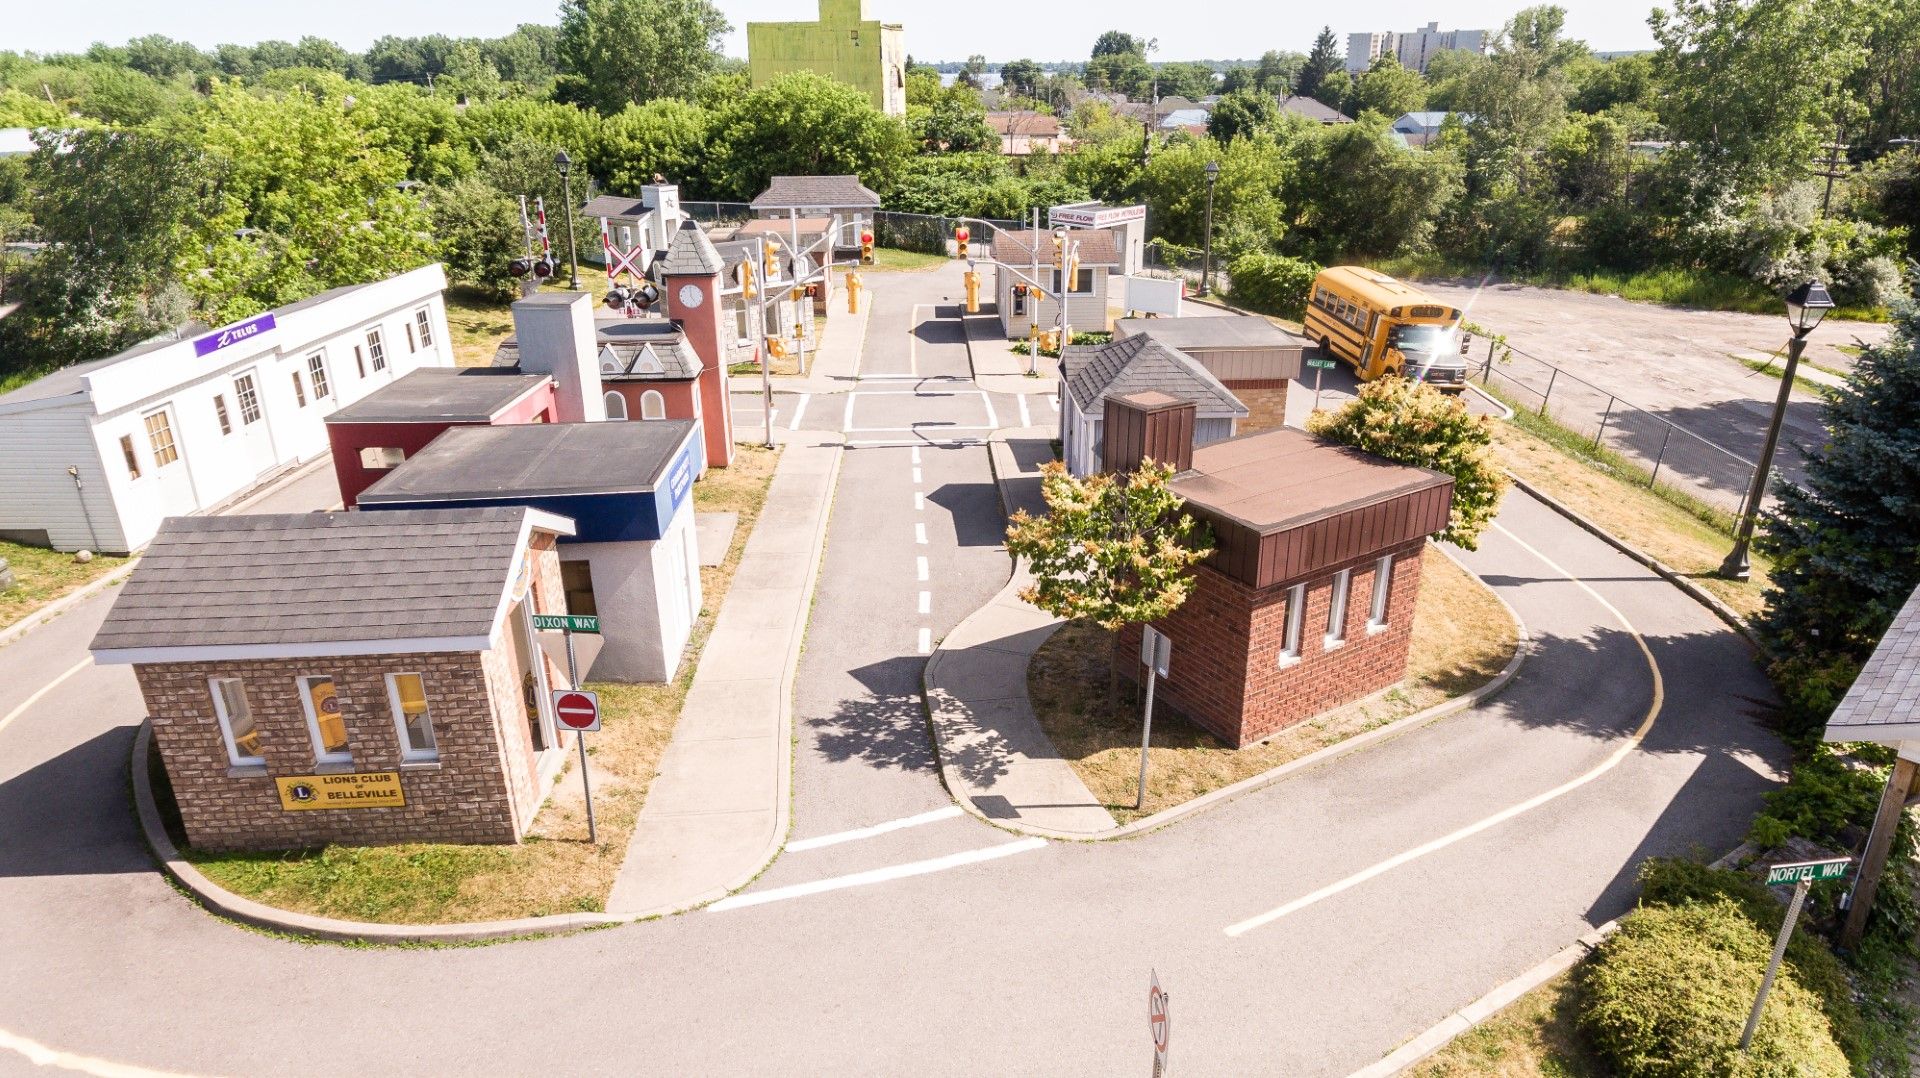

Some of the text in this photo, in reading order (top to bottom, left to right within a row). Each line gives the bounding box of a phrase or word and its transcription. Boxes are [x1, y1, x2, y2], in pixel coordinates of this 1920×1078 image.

[1058, 212, 1094, 222] FREE FLOW
[231, 324, 258, 340] TELUS
[534, 617, 596, 629] DIXON WAY
[323, 774, 391, 785] LIONS CLUB
[297, 787, 307, 798] L
[327, 789, 397, 800] BELLEVILLE
[1768, 862, 1848, 883] NORTEL WAY
